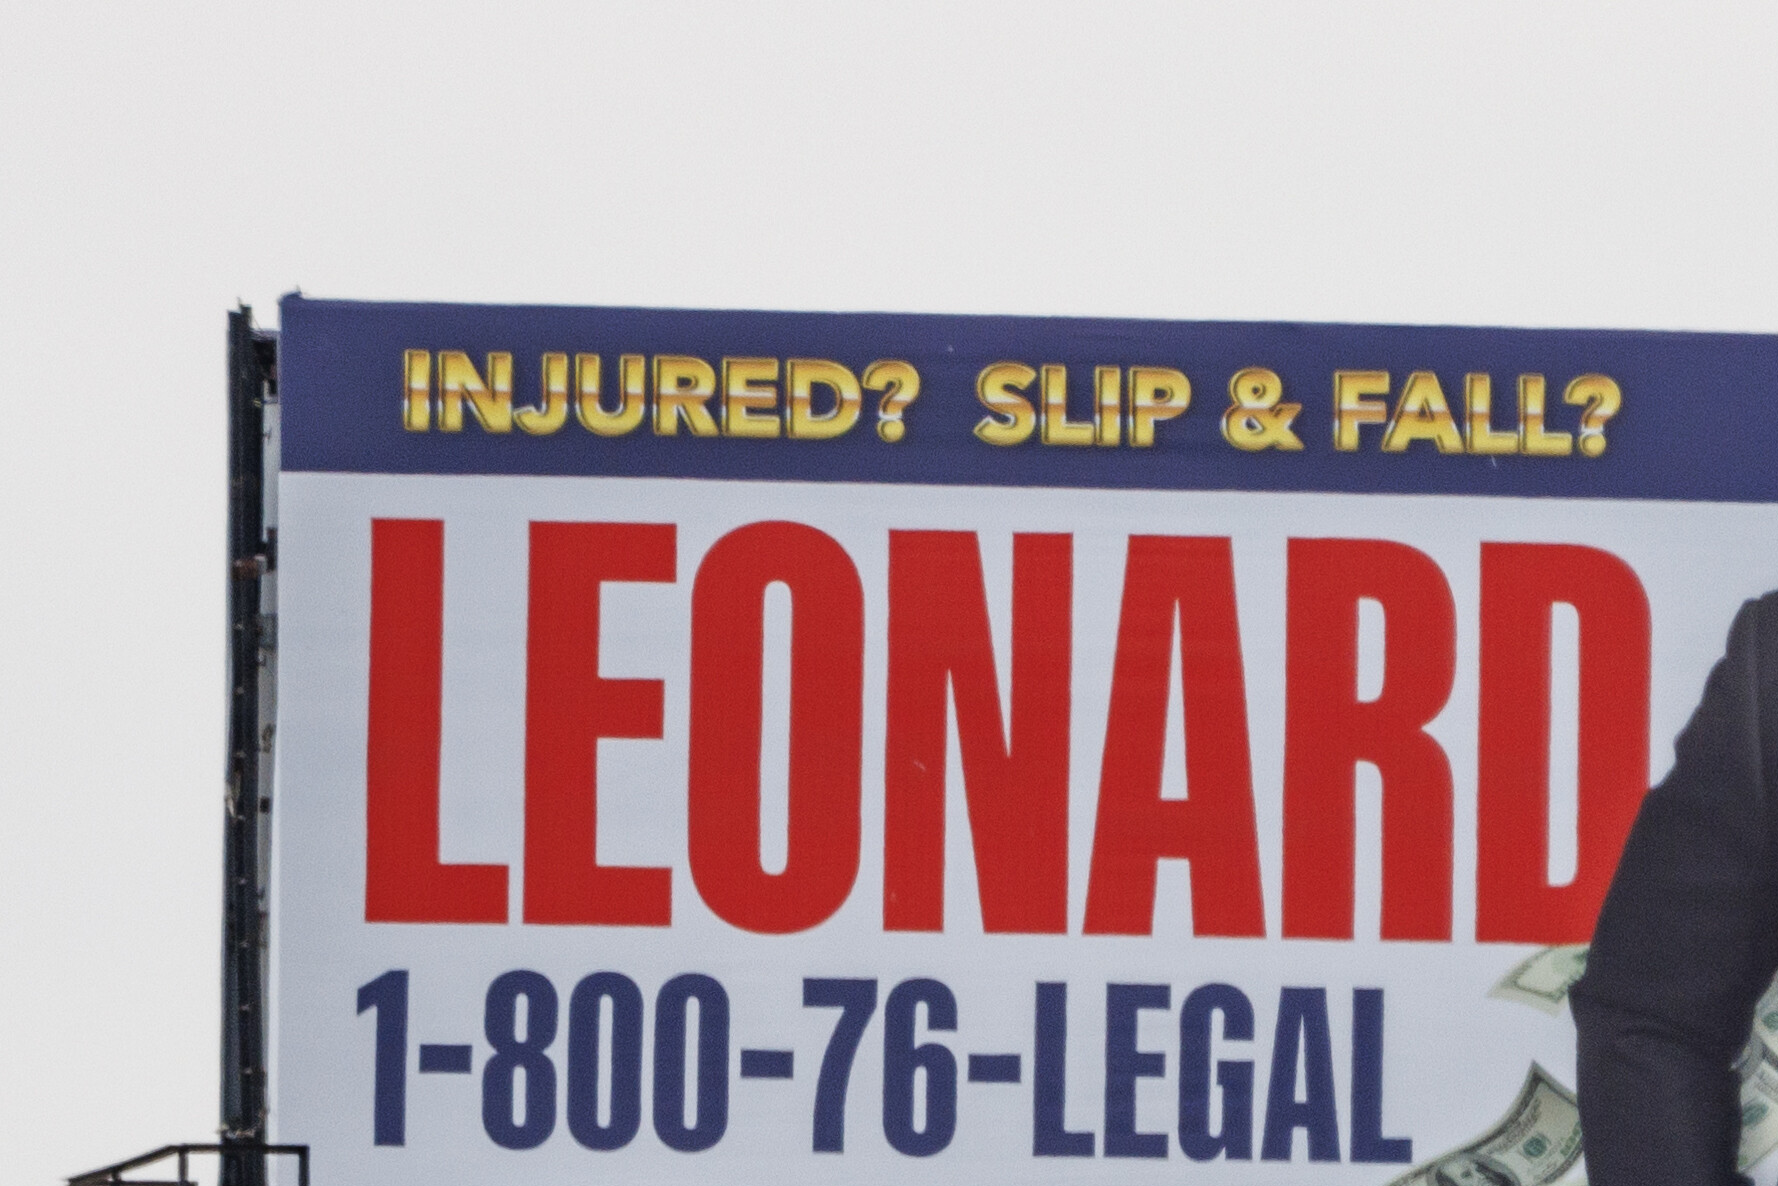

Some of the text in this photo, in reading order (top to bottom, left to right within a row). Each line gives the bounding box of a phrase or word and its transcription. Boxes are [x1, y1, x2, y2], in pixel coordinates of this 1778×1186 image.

[403, 349, 1622, 458] INJURED? SLIP & FALL?
[364, 518, 1653, 946] LEONARD
[357, 969, 1413, 1164] 1-800-76-LEGAL
